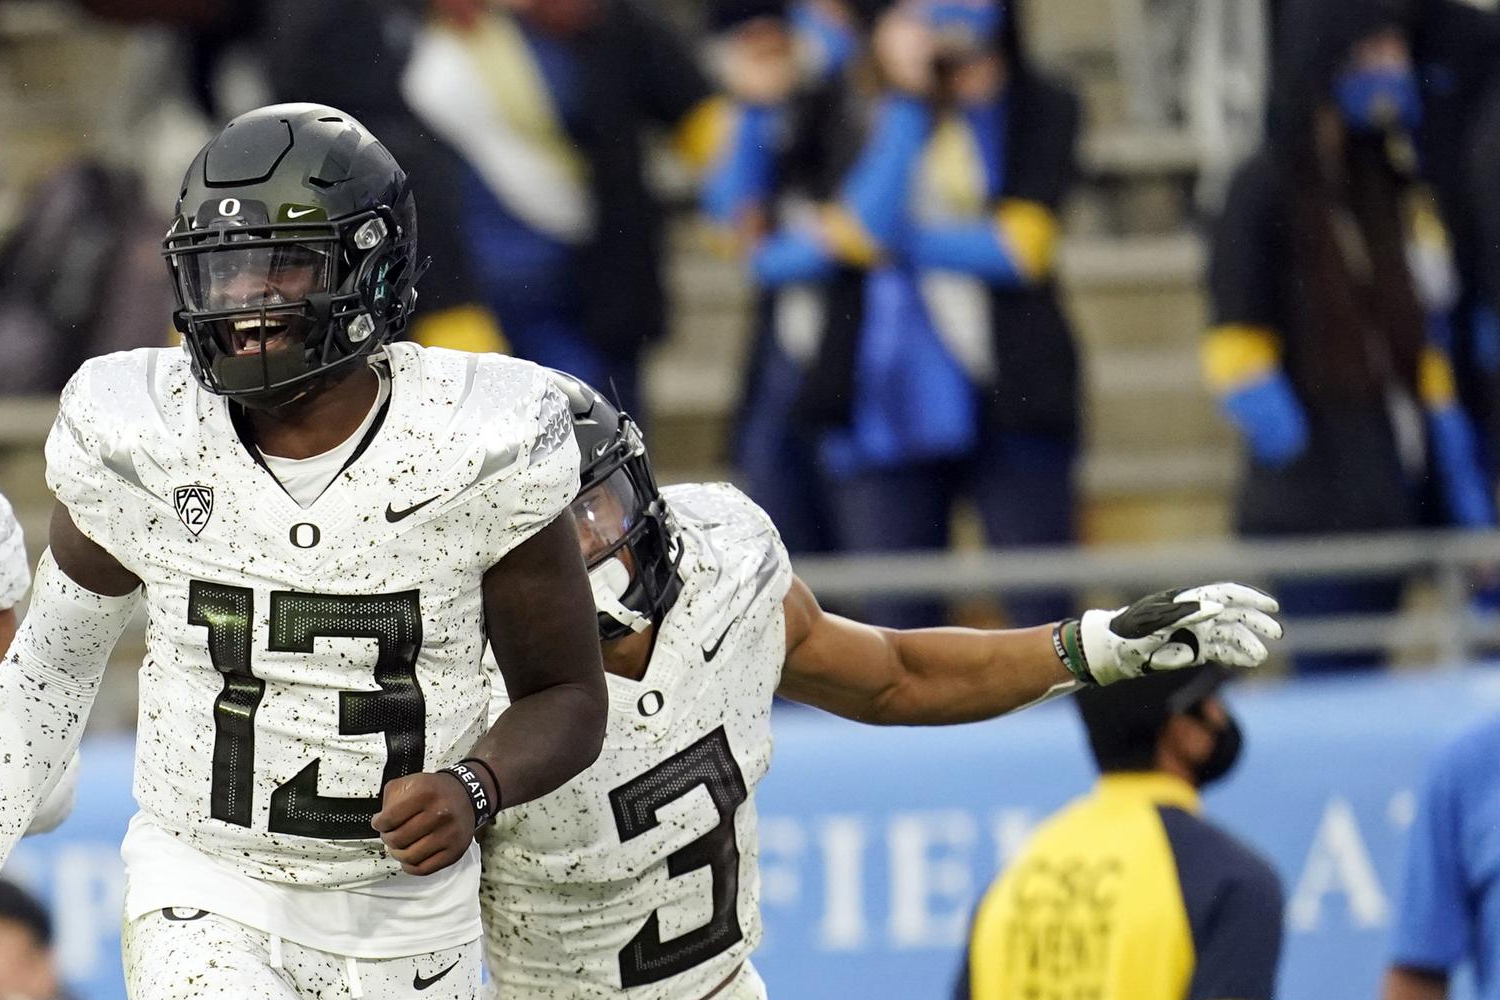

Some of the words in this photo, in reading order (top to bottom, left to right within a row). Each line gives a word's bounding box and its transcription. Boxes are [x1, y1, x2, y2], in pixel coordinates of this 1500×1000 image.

[188, 580, 425, 840] 13
[450, 764, 488, 810] REATS
[608, 724, 749, 990] 3
